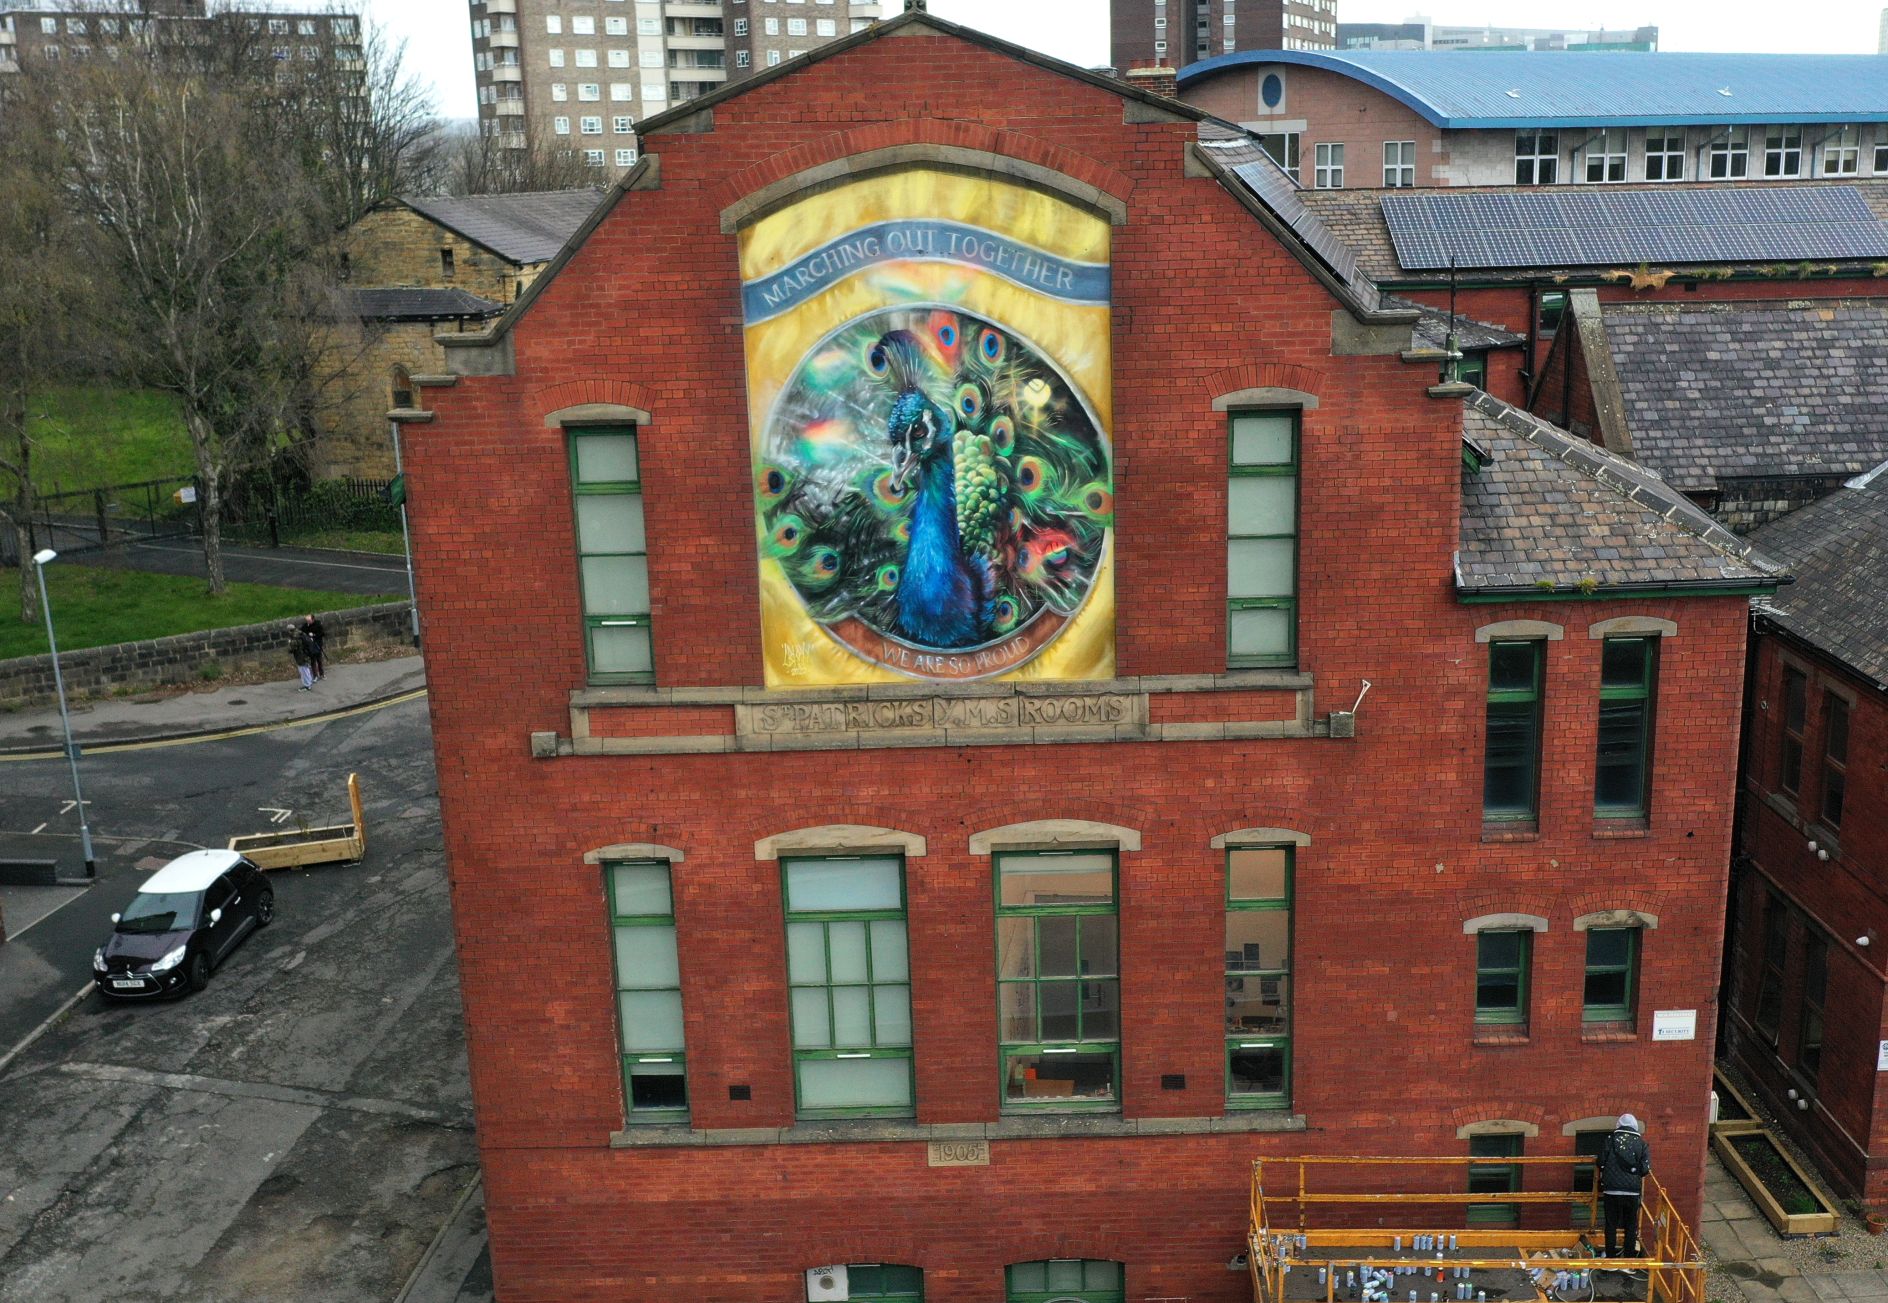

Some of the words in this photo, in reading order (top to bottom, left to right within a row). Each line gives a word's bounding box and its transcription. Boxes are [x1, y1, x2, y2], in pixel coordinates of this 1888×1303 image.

[762, 237, 881, 307] MARCHING
[887, 229, 938, 252] OUT
[945, 232, 1073, 290] TOGETHER
[883, 641, 910, 668] WE
[913, 655, 945, 674] ARE
[949, 656, 970, 675] SO
[975, 636, 1030, 671] PROUD
[792, 700, 930, 731] PATRICKS
[1022, 695, 1126, 724] ROOMS
[939, 1143, 979, 1162] 1905
